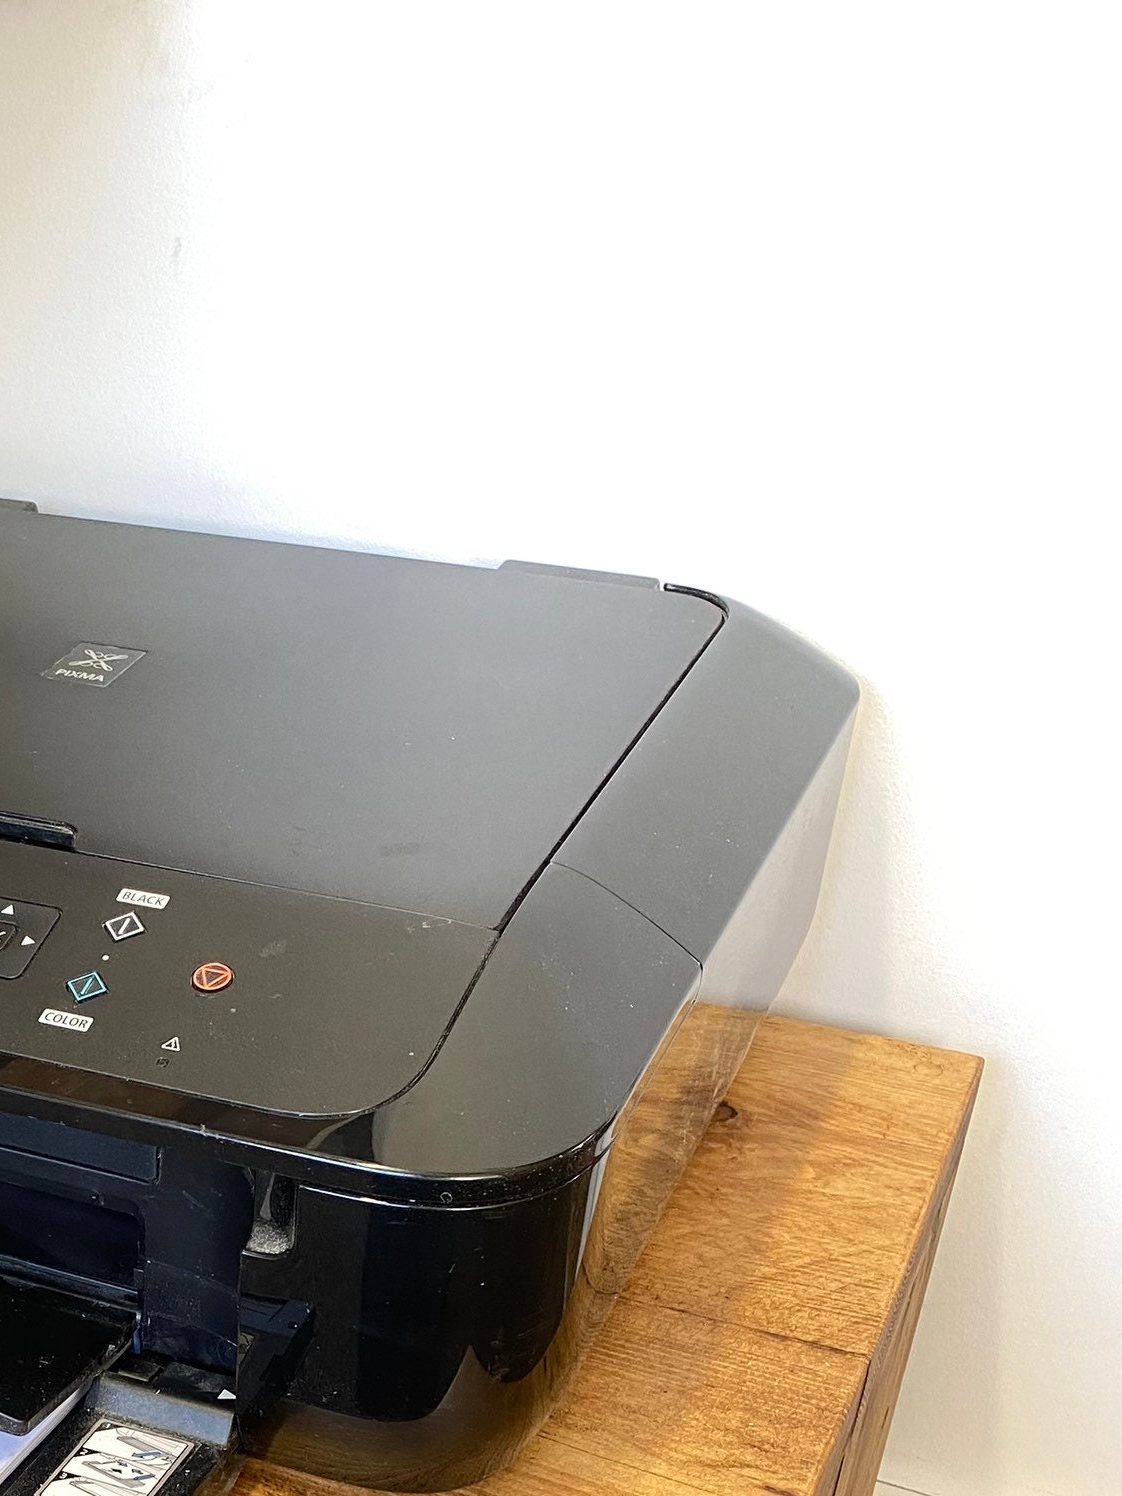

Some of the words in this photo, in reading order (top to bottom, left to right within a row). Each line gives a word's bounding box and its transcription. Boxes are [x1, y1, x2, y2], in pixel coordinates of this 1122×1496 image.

[55, 668, 104, 682] PIXMA
[122, 891, 165, 907] BLACK
[44, 1011, 89, 1030] COLOR
